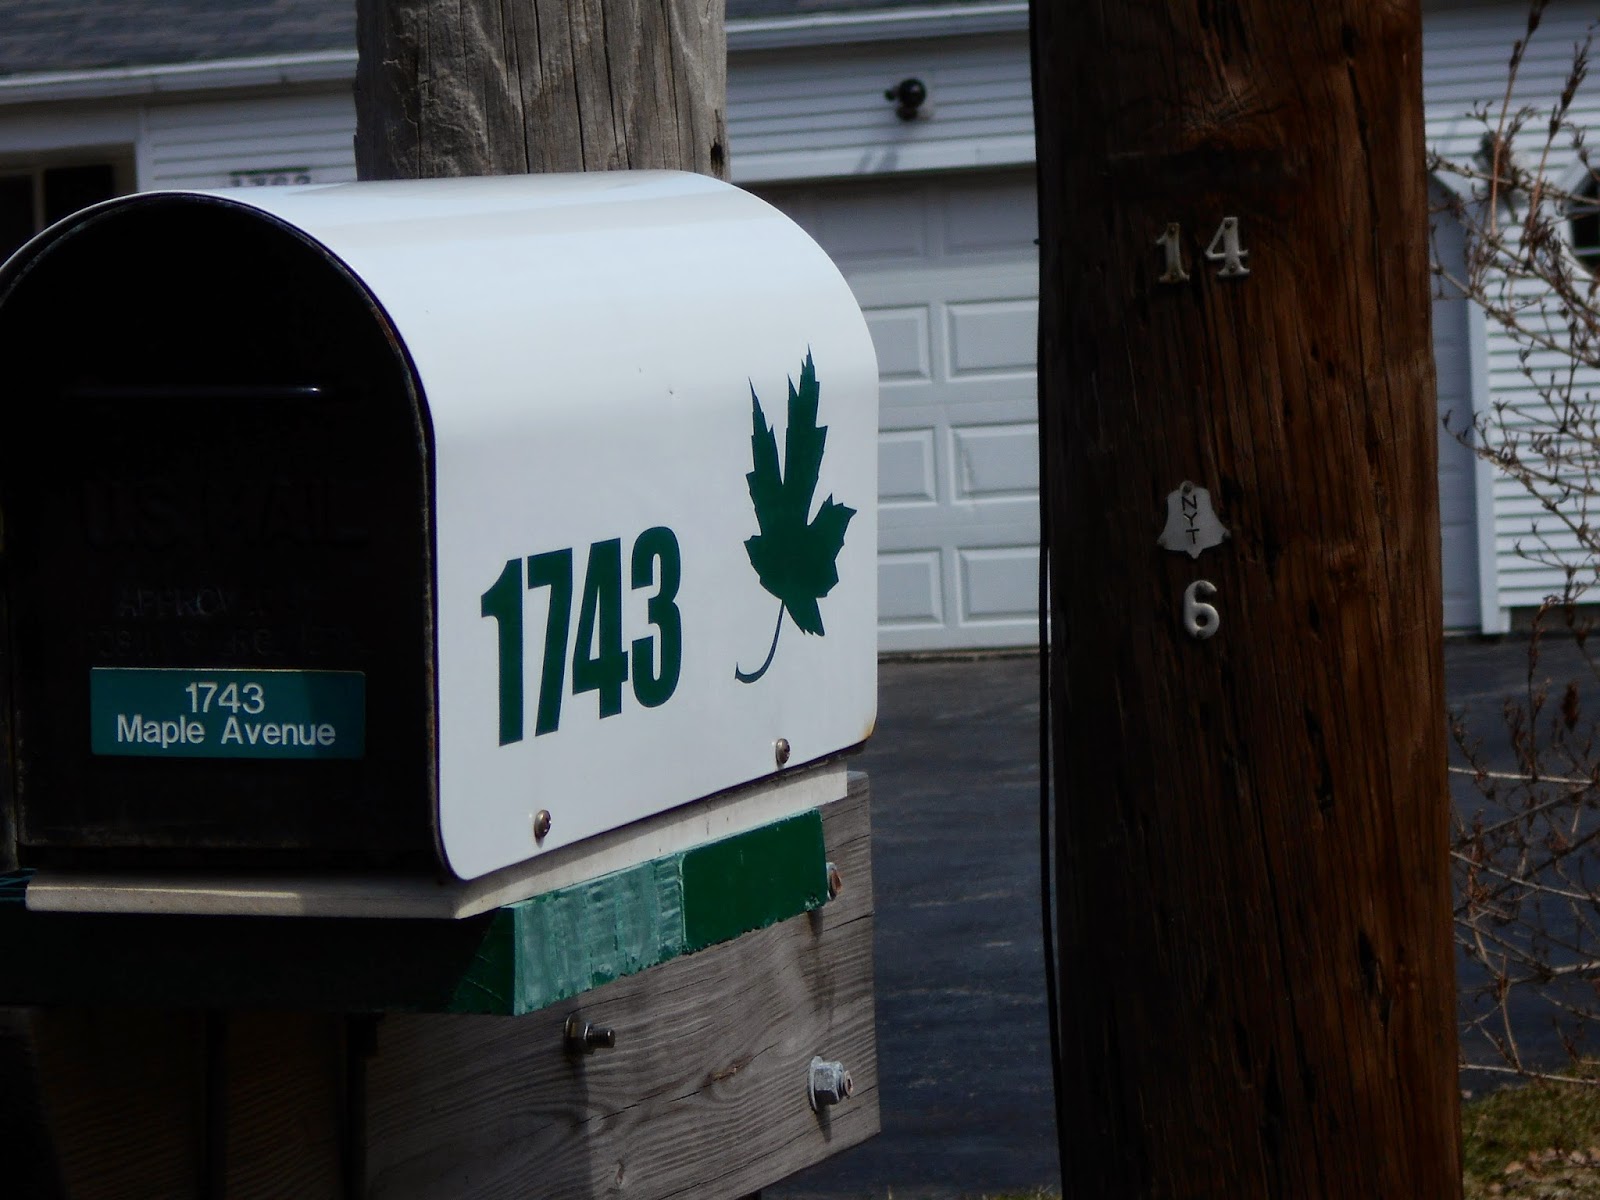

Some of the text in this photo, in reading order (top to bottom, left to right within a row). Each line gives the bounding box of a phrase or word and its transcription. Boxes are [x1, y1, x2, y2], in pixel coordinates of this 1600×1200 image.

[1181, 495, 1200, 545] NYT
[1183, 579, 1220, 640] 6
[481, 526, 682, 747] 1743
[185, 682, 265, 714] 1743
[117, 714, 336, 748] Maple Avenue
